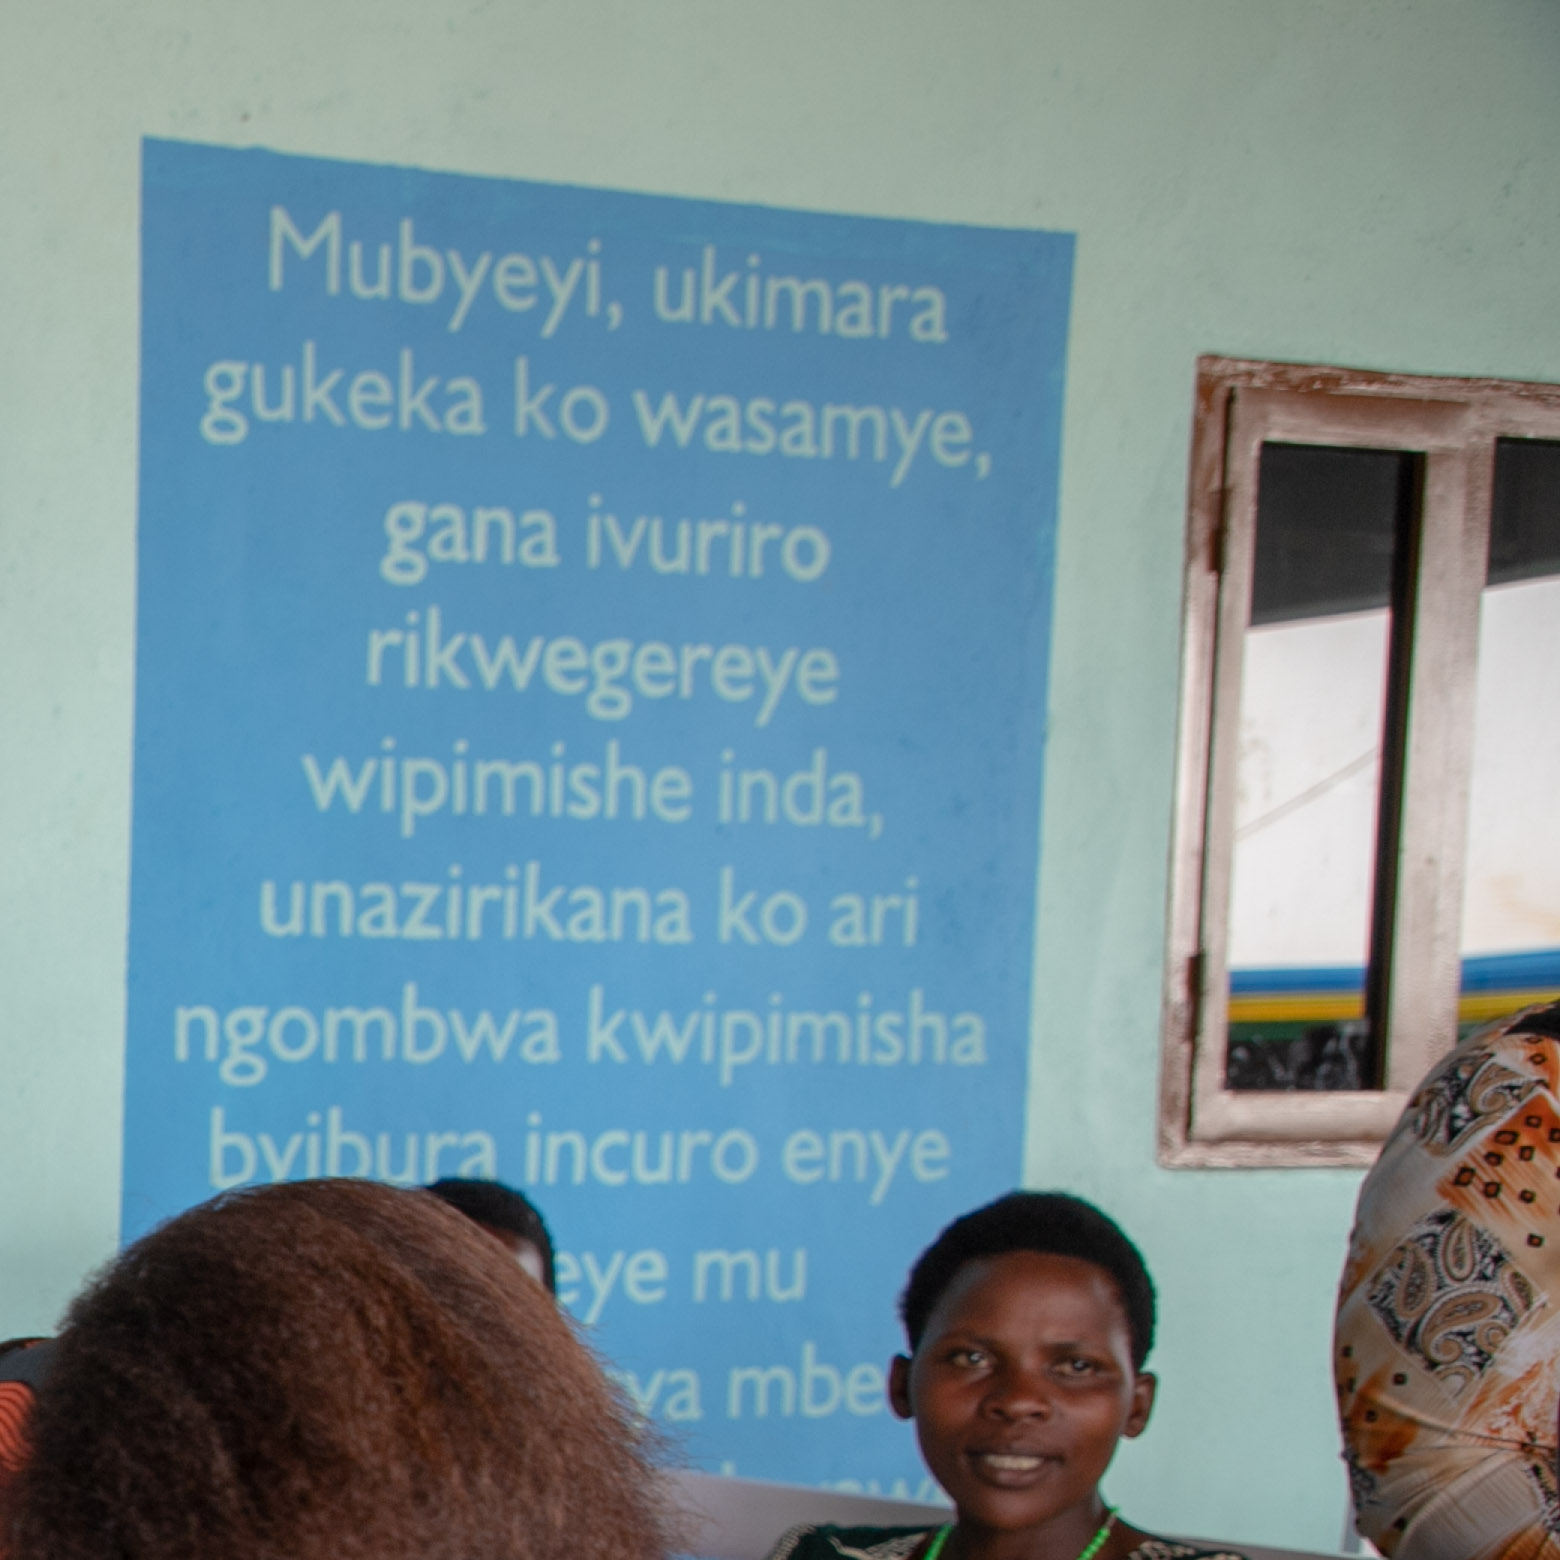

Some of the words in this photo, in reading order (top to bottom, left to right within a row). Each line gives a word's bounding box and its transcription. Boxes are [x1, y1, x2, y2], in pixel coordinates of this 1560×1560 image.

[269, 205, 623, 338] Mubyeyi,
[654, 244, 949, 343] ukimara
[200, 339, 487, 445] gukeka
[515, 356, 610, 444] ko
[633, 389, 991, 488] wasamye,
[380, 500, 561, 585] gana
[587, 493, 832, 582] ivuriro
[367, 605, 840, 728] rikwegereye
[302, 736, 694, 838] wipimishe
[719, 747, 883, 838] inda,
[260, 860, 695, 945] unazirikana
[719, 865, 808, 946] ko
[828, 876, 919, 947] ari
[175, 981, 562, 1087] ngombwa
[587, 983, 988, 1087] kwipimisha
[209, 1105, 498, 1191] byibura
[525, 1111, 760, 1186] incuro
[782, 1128, 952, 1205] enye
[694, 1248, 807, 1302] mu
